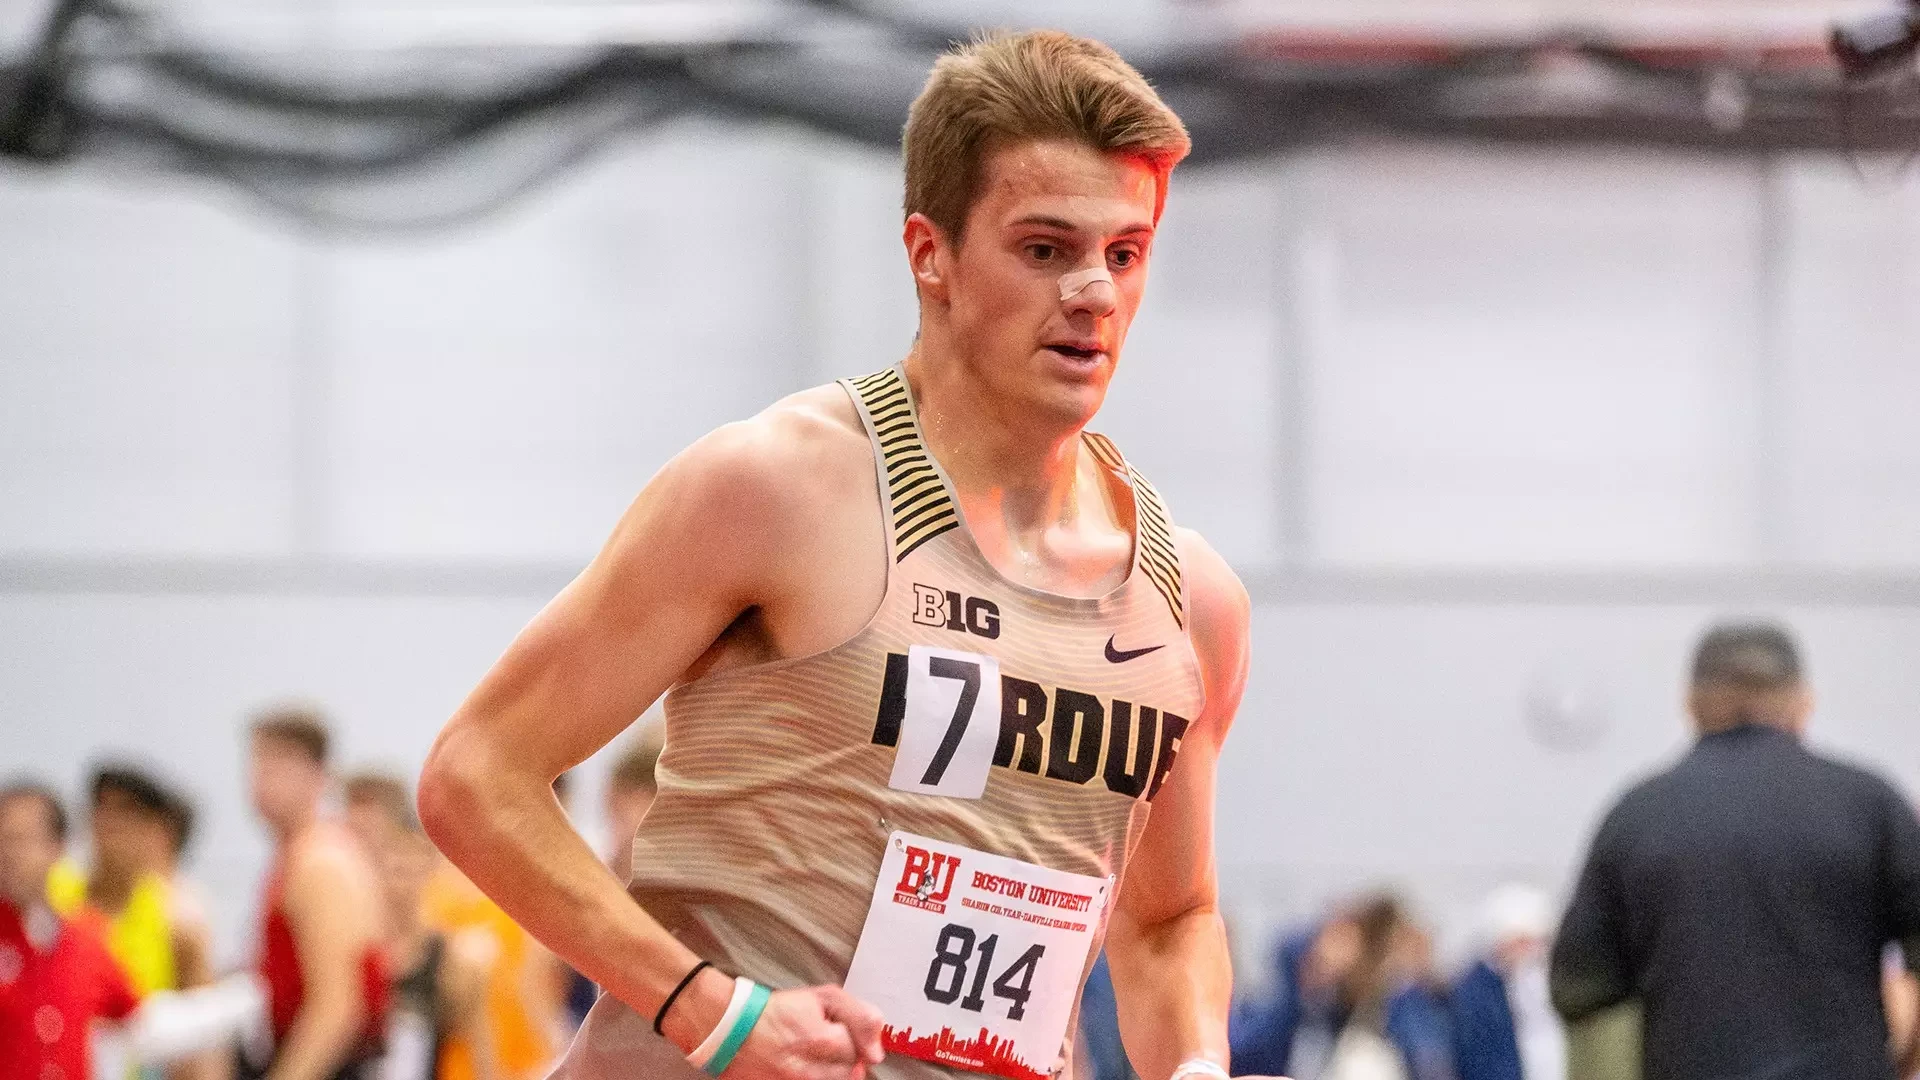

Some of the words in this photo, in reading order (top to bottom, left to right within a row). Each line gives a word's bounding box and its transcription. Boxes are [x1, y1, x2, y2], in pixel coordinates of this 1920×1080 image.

[919, 656, 981, 786] 7
[896, 845, 961, 902] BU
[971, 870, 1028, 899] BOSTON
[1028, 884, 1093, 912] UNIVERSITY
[924, 900, 943, 912] FIELD
[923, 923, 1046, 1021] 814
